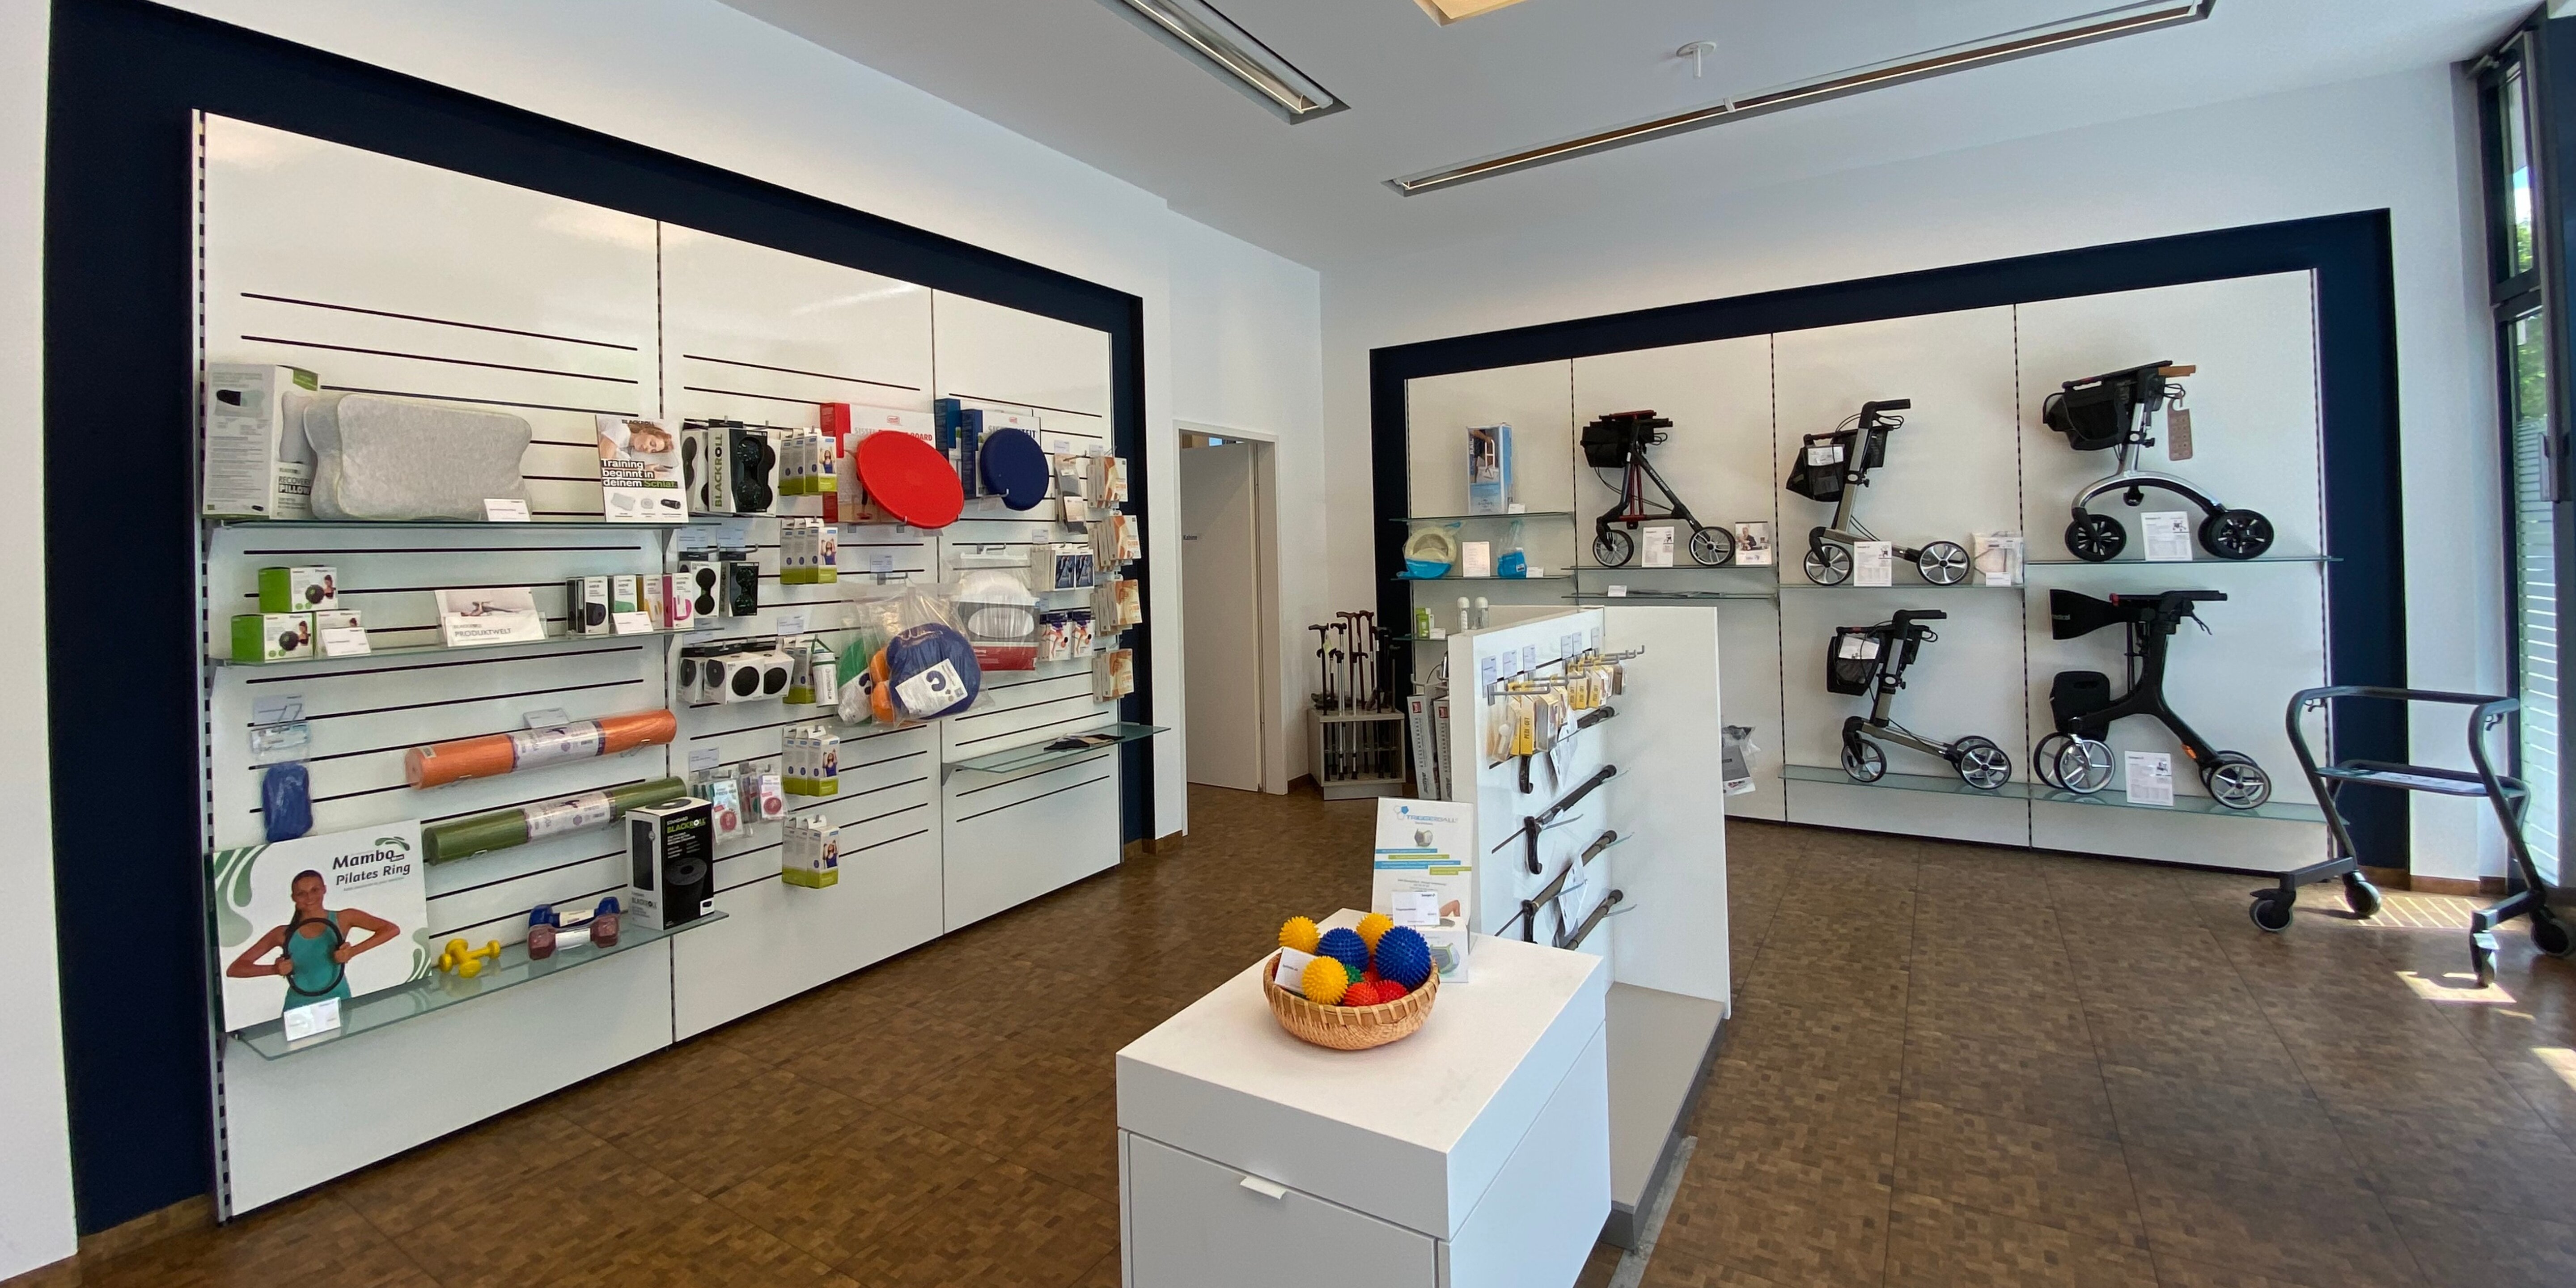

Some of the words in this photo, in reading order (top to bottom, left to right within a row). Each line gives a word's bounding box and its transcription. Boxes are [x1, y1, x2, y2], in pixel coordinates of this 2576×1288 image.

[601, 459, 644, 469] Training
[602, 469, 642, 478] beginnt
[603, 479, 642, 487] deinem
[454, 628, 511, 636] PRODUKTWELT
[667, 818, 706, 833] BLACKROLL
[332, 849, 394, 870] Mambo
[336, 871, 378, 886] Pilates
[383, 864, 411, 876] Ring
